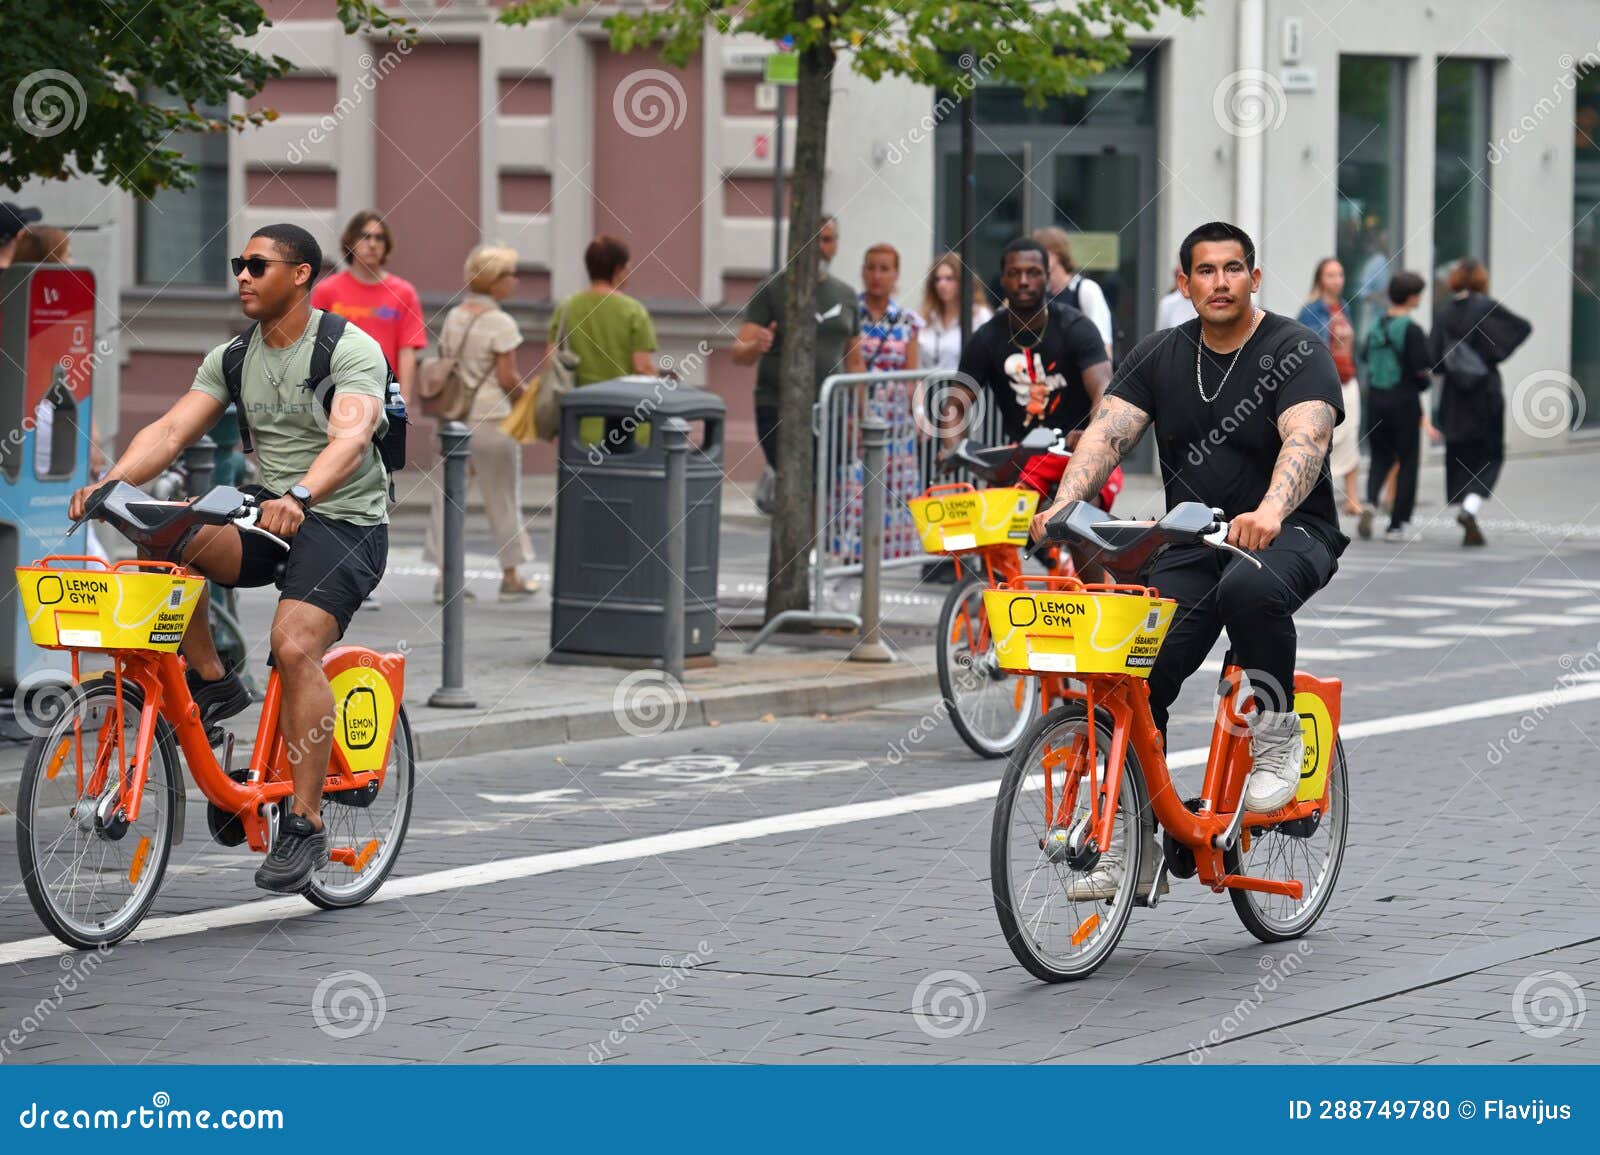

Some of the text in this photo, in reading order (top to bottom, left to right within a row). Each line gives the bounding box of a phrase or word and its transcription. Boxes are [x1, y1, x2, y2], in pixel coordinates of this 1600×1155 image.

[66, 580, 108, 593] LEMON
[69, 592, 97, 605] GYM
[1040, 601, 1085, 615] LEMON
[154, 622, 174, 631] LEMON
[1043, 615, 1071, 628] GYM
[349, 719, 373, 729] LEMON
[350, 730, 367, 740] GYM
